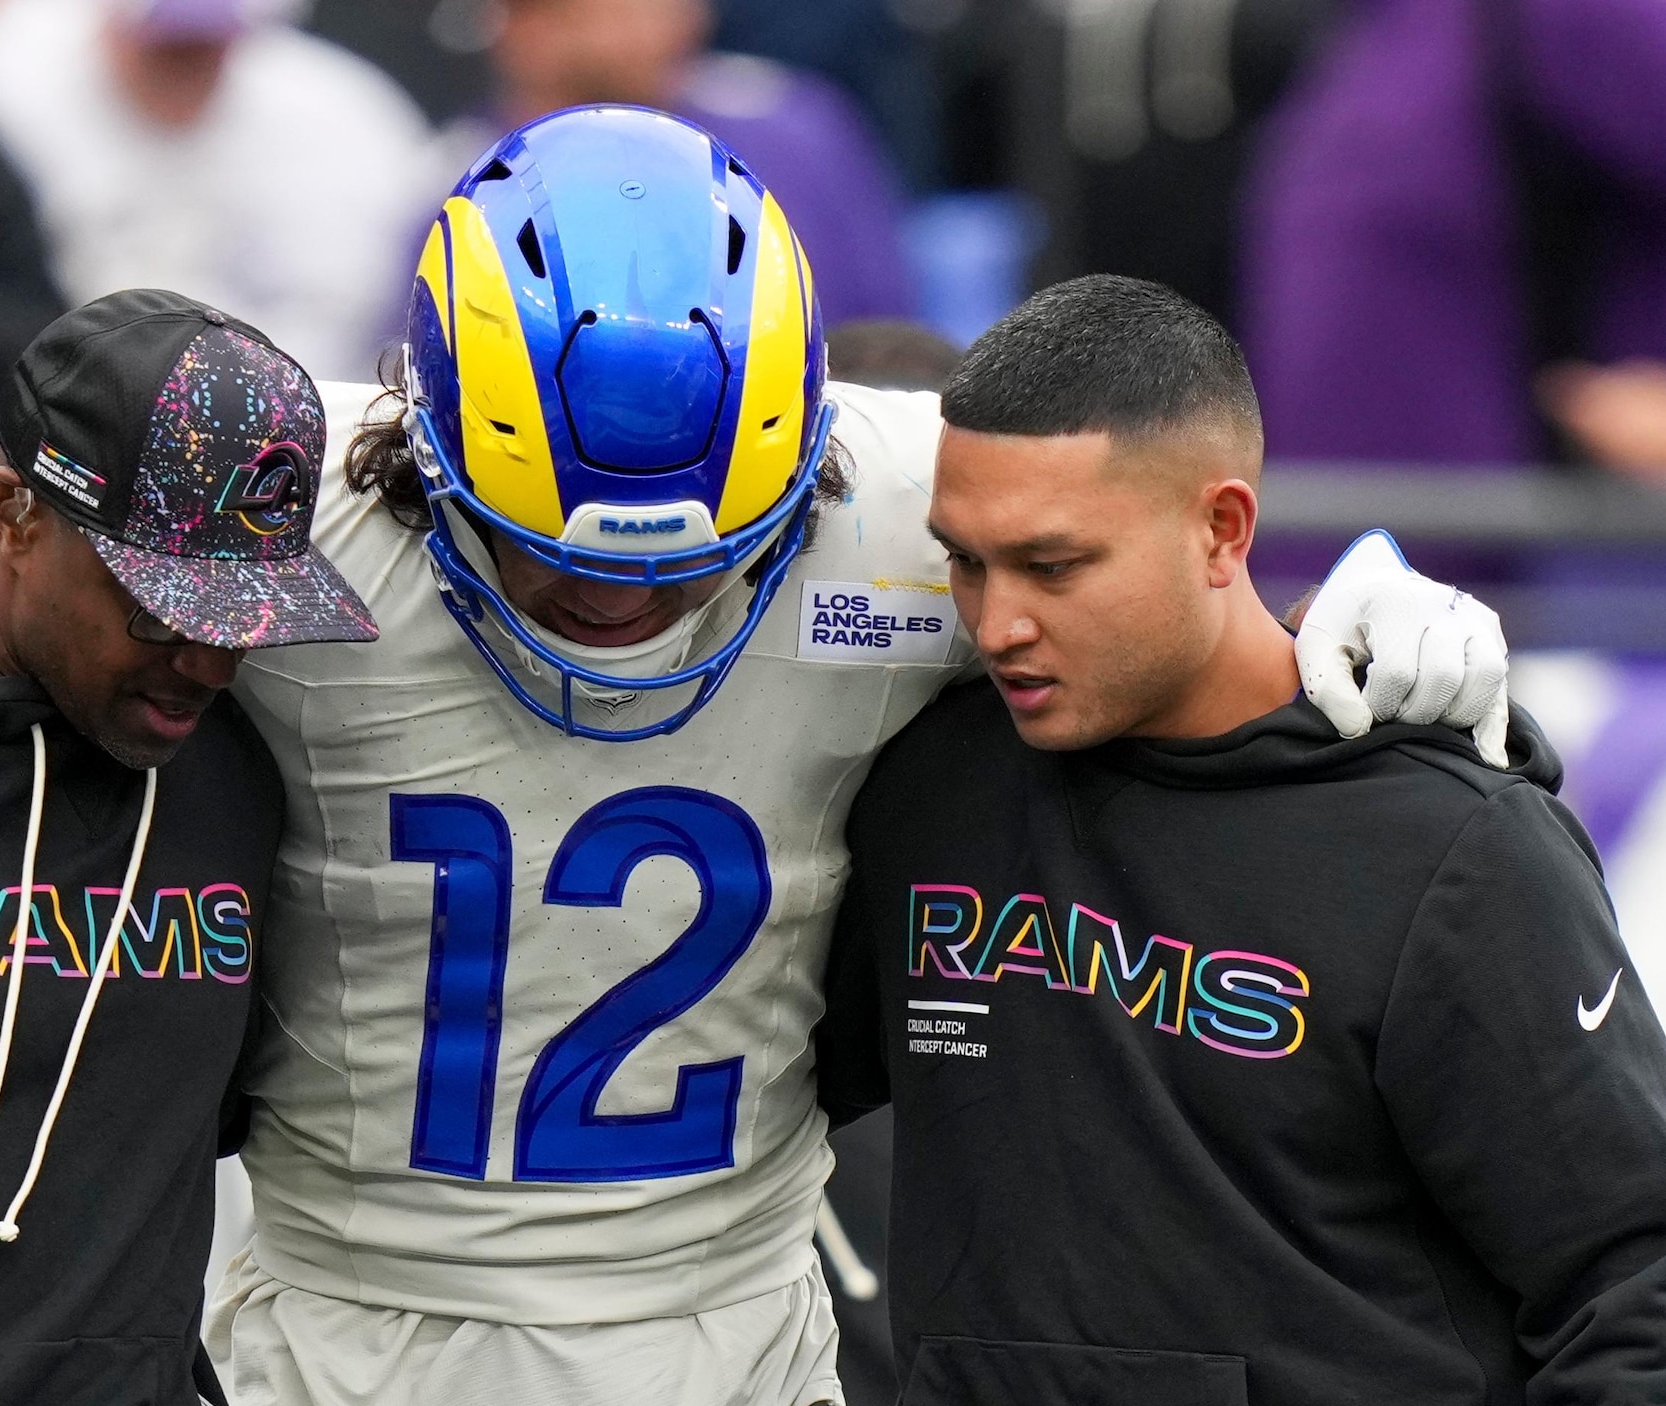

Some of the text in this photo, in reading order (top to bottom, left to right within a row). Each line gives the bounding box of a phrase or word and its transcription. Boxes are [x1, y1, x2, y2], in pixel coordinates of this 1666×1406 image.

[598, 516, 686, 535] RAMS
[814, 593, 870, 612] LOS
[812, 611, 944, 633] ANGELES
[812, 628, 893, 648] RAMS
[909, 884, 1309, 1059] RAMS
[390, 785, 773, 1182] 12
[907, 1019, 966, 1035] CRUCIAL CATCH
[944, 1041, 987, 1058] CANCER
